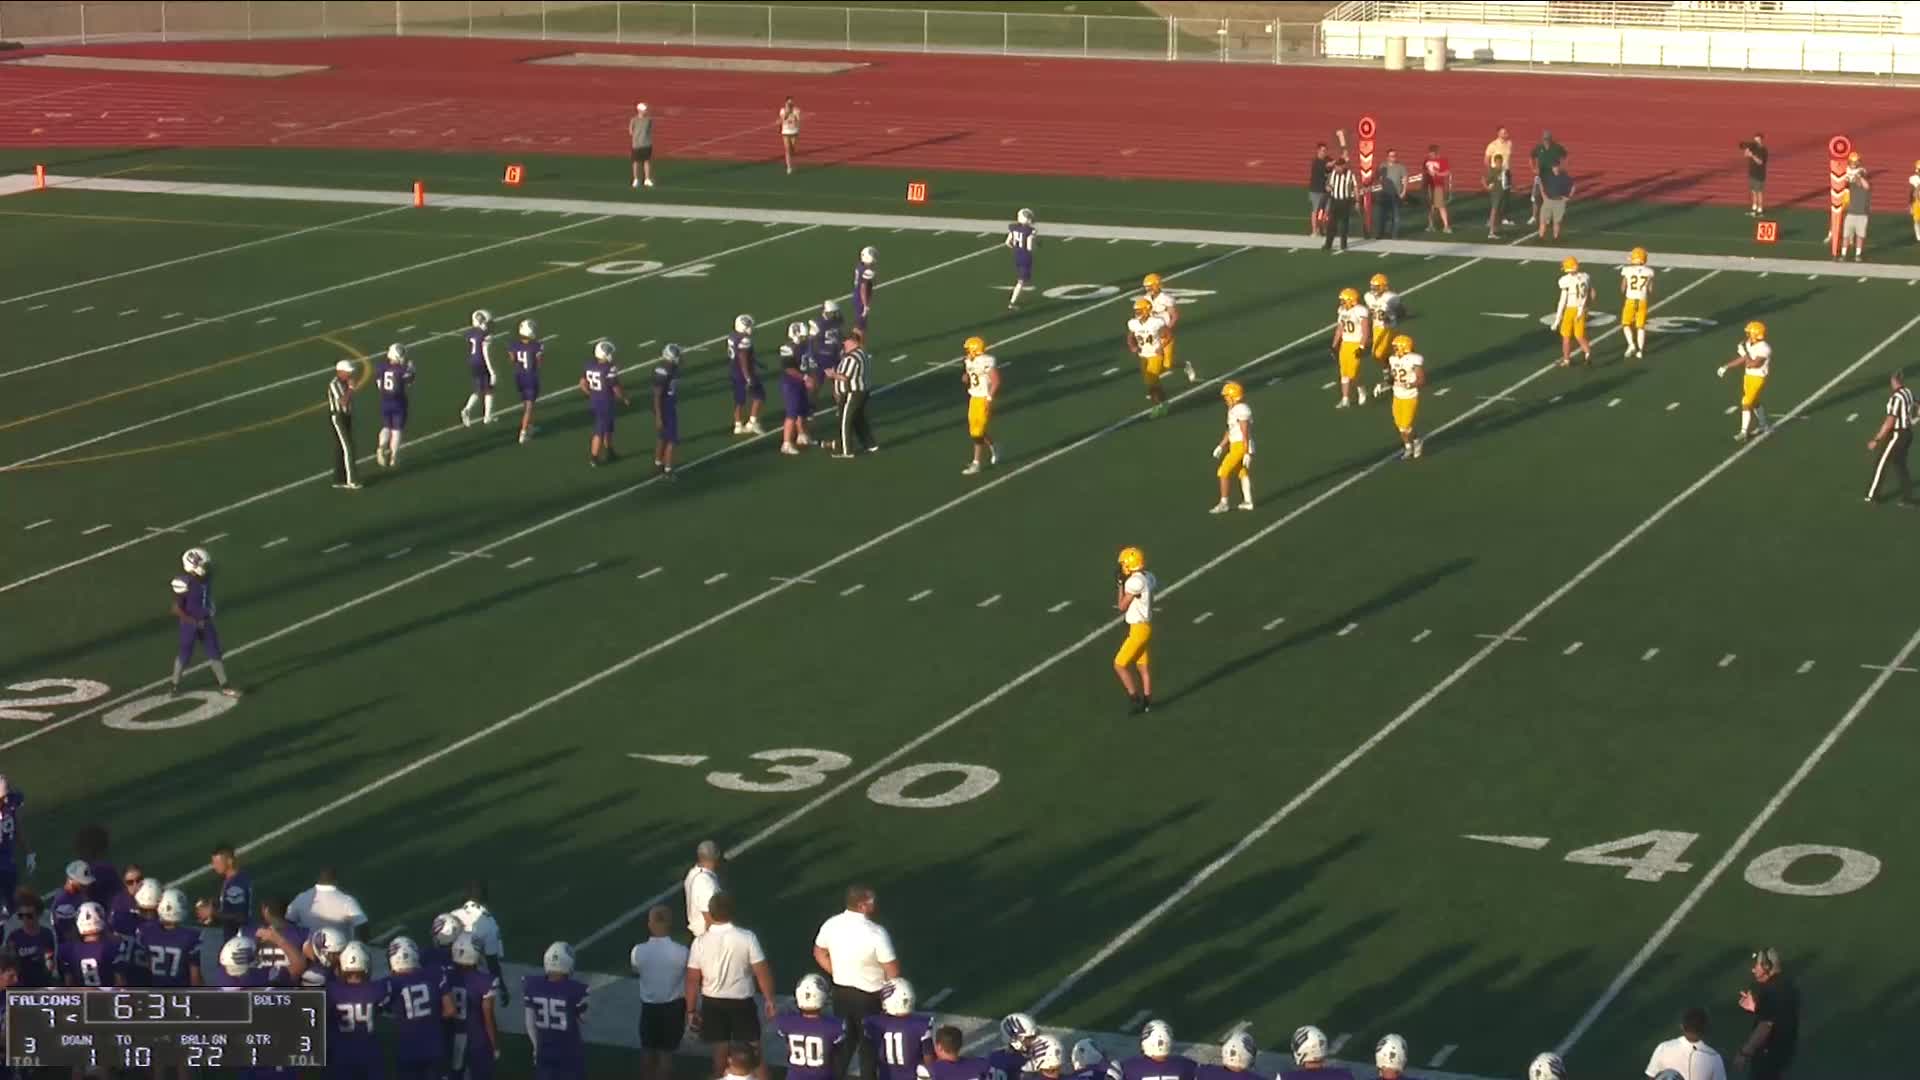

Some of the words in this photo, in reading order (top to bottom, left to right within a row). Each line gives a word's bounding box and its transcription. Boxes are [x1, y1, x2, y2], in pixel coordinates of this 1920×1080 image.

[911, 184, 923, 199] 10
[1758, 224, 1774, 239] 30
[1629, 275, 1648, 291] 27
[384, 371, 394, 391] 6
[149, 945, 182, 977] 27
[401, 984, 431, 1020] 12
[533, 998, 568, 1031] 35
[336, 1003, 374, 1032] 34
[883, 1031, 905, 1066] 11
